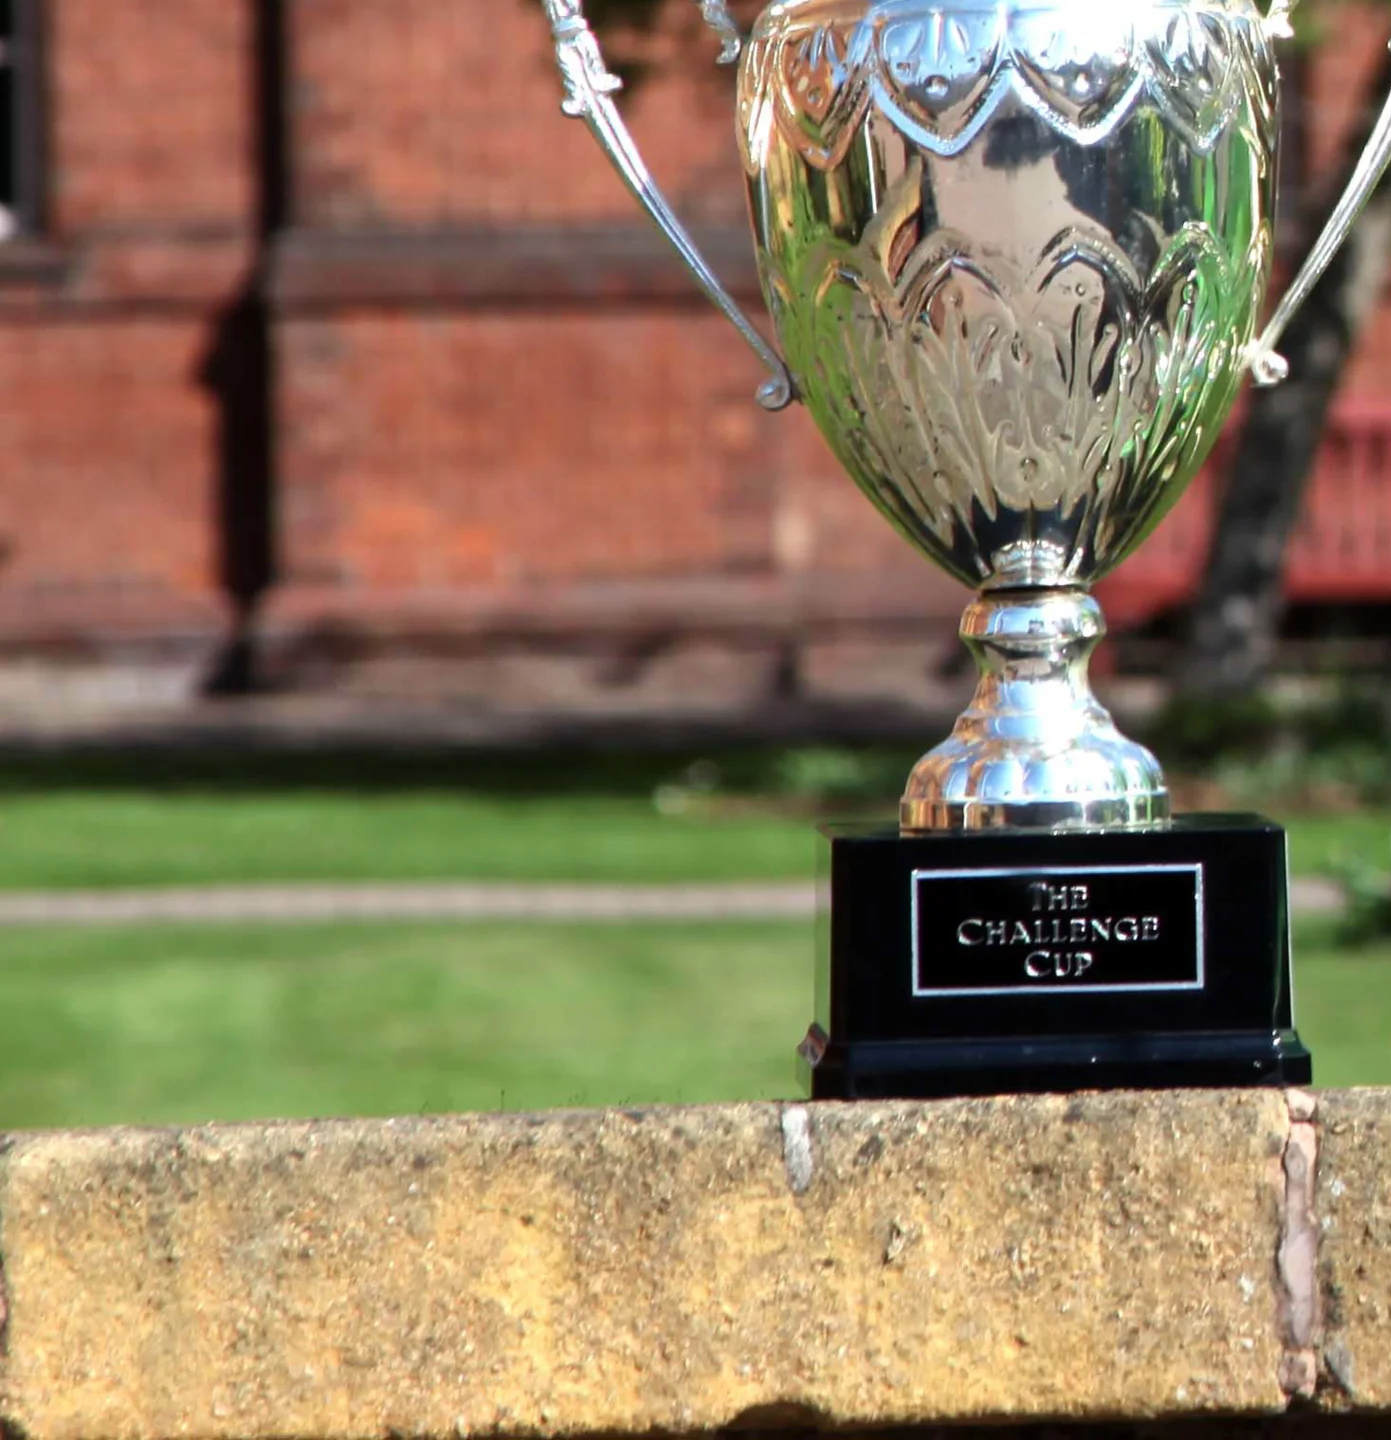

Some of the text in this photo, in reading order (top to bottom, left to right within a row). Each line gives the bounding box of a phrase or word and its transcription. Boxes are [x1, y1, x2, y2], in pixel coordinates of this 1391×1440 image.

[1026, 881, 1089, 911] THE
[956, 916, 1160, 946] CHALLENGE
[1023, 950, 1093, 978] CUP
